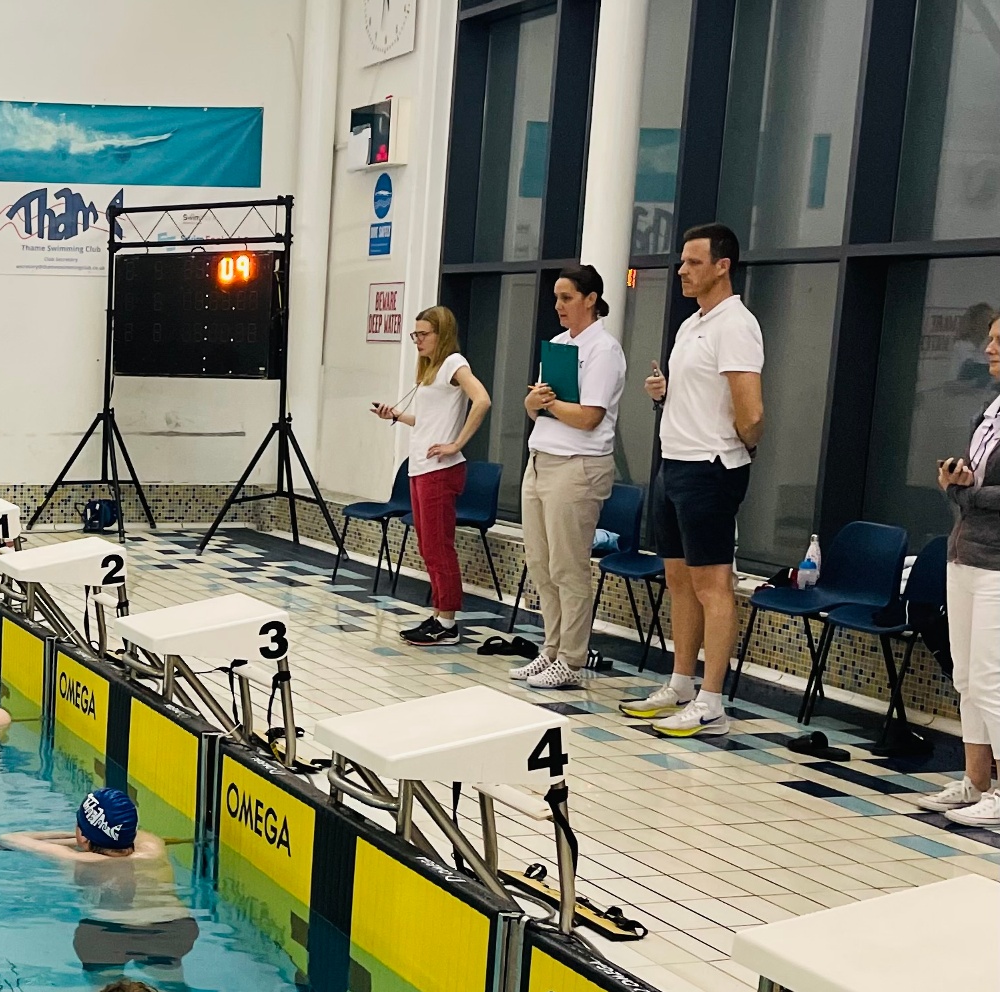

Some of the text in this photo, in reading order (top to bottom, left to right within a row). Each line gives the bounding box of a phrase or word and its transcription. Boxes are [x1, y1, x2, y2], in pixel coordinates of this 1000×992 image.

[47, 245, 84, 254] Swimming
[219, 254, 251, 282] 09
[375, 291, 397, 311] BEWARE
[369, 314, 402, 334] DEEP WATER
[100, 554, 125, 585] 2
[259, 621, 288, 659] 3
[59, 671, 96, 720] OMEGA
[527, 726, 568, 777] 4
[226, 782, 292, 858] OMEGA
